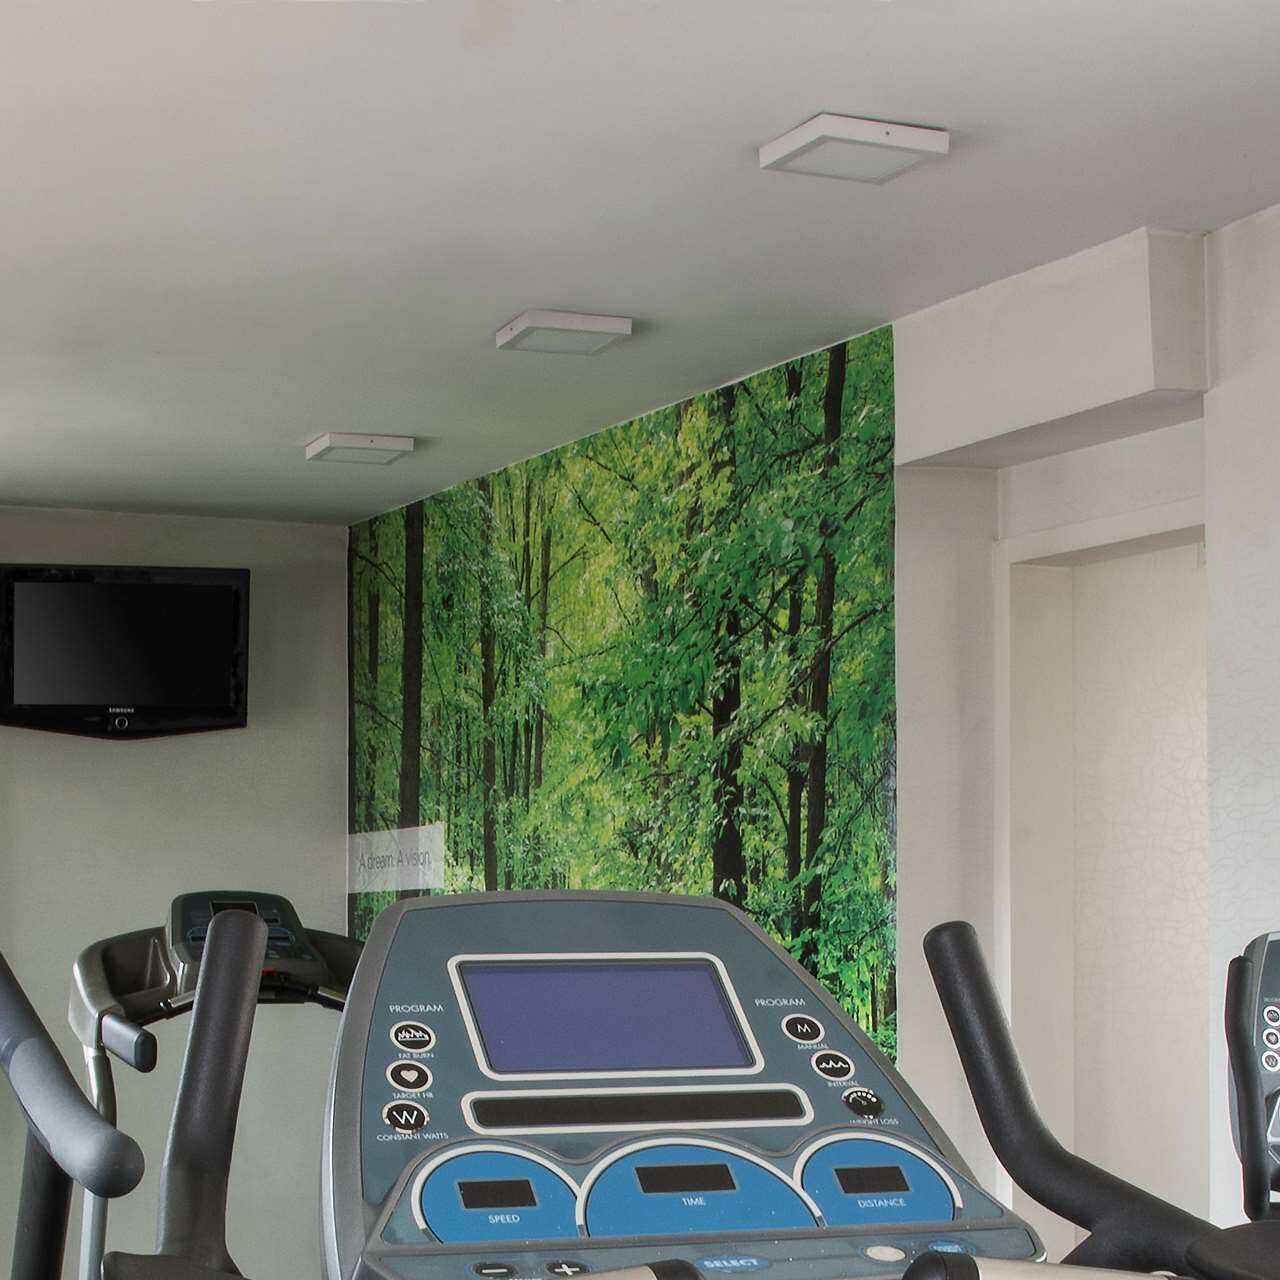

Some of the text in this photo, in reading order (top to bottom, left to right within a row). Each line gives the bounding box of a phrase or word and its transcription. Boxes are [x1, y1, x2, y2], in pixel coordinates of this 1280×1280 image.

[754, 998, 806, 1007] PROGRAM
[389, 1004, 444, 1013] PROGRAM
[797, 1023, 811, 1033] M
[393, 1110, 418, 1124] W
[376, 1131, 449, 1141] CONSTANT WATTS
[681, 1197, 707, 1207] TIME
[857, 1198, 907, 1208] DISTANCE
[488, 1214, 520, 1224] SPEED
[703, 1258, 759, 1268] SELECT
